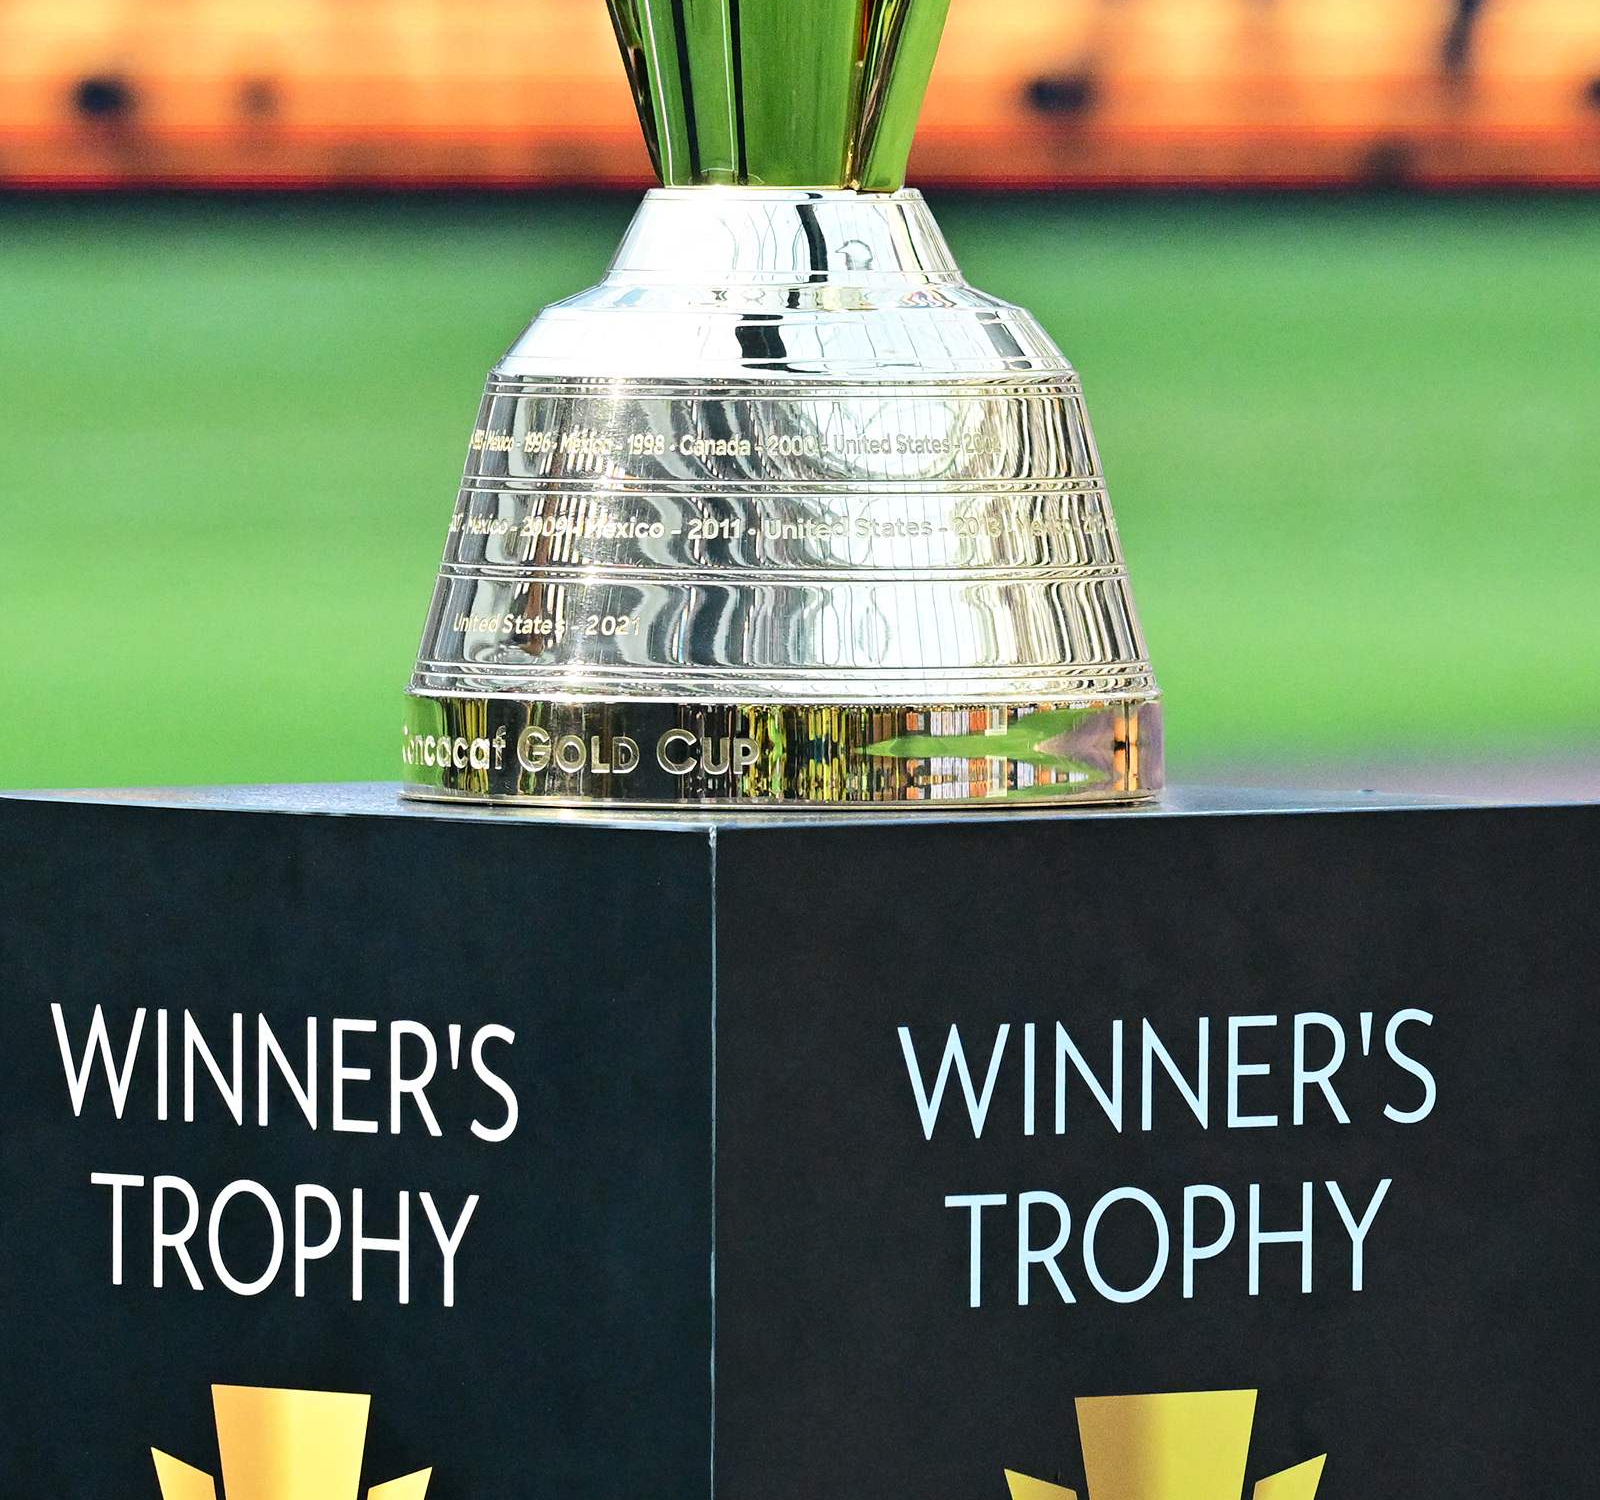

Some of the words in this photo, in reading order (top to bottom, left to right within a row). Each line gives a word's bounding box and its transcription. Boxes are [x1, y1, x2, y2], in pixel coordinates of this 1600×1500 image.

[523, 431, 553, 453] 1996
[628, 433, 665, 456] 1998
[679, 433, 751, 457] Canada
[766, 434, 819, 457] 2000
[833, 433, 892, 455] United
[895, 433, 951, 455] States
[520, 514, 569, 538] 2009
[687, 517, 742, 540] 2011
[764, 516, 849, 540] United
[854, 516, 933, 538] States
[453, 612, 499, 634] United
[502, 612, 567, 636] States
[585, 614, 642, 637] 2021
[50, 1002, 520, 1143] WINNER'S
[897, 1007, 1438, 1141] WINNER'S
[90, 1171, 480, 1308] TROPHY
[944, 1177, 1393, 1309] TROPHY
